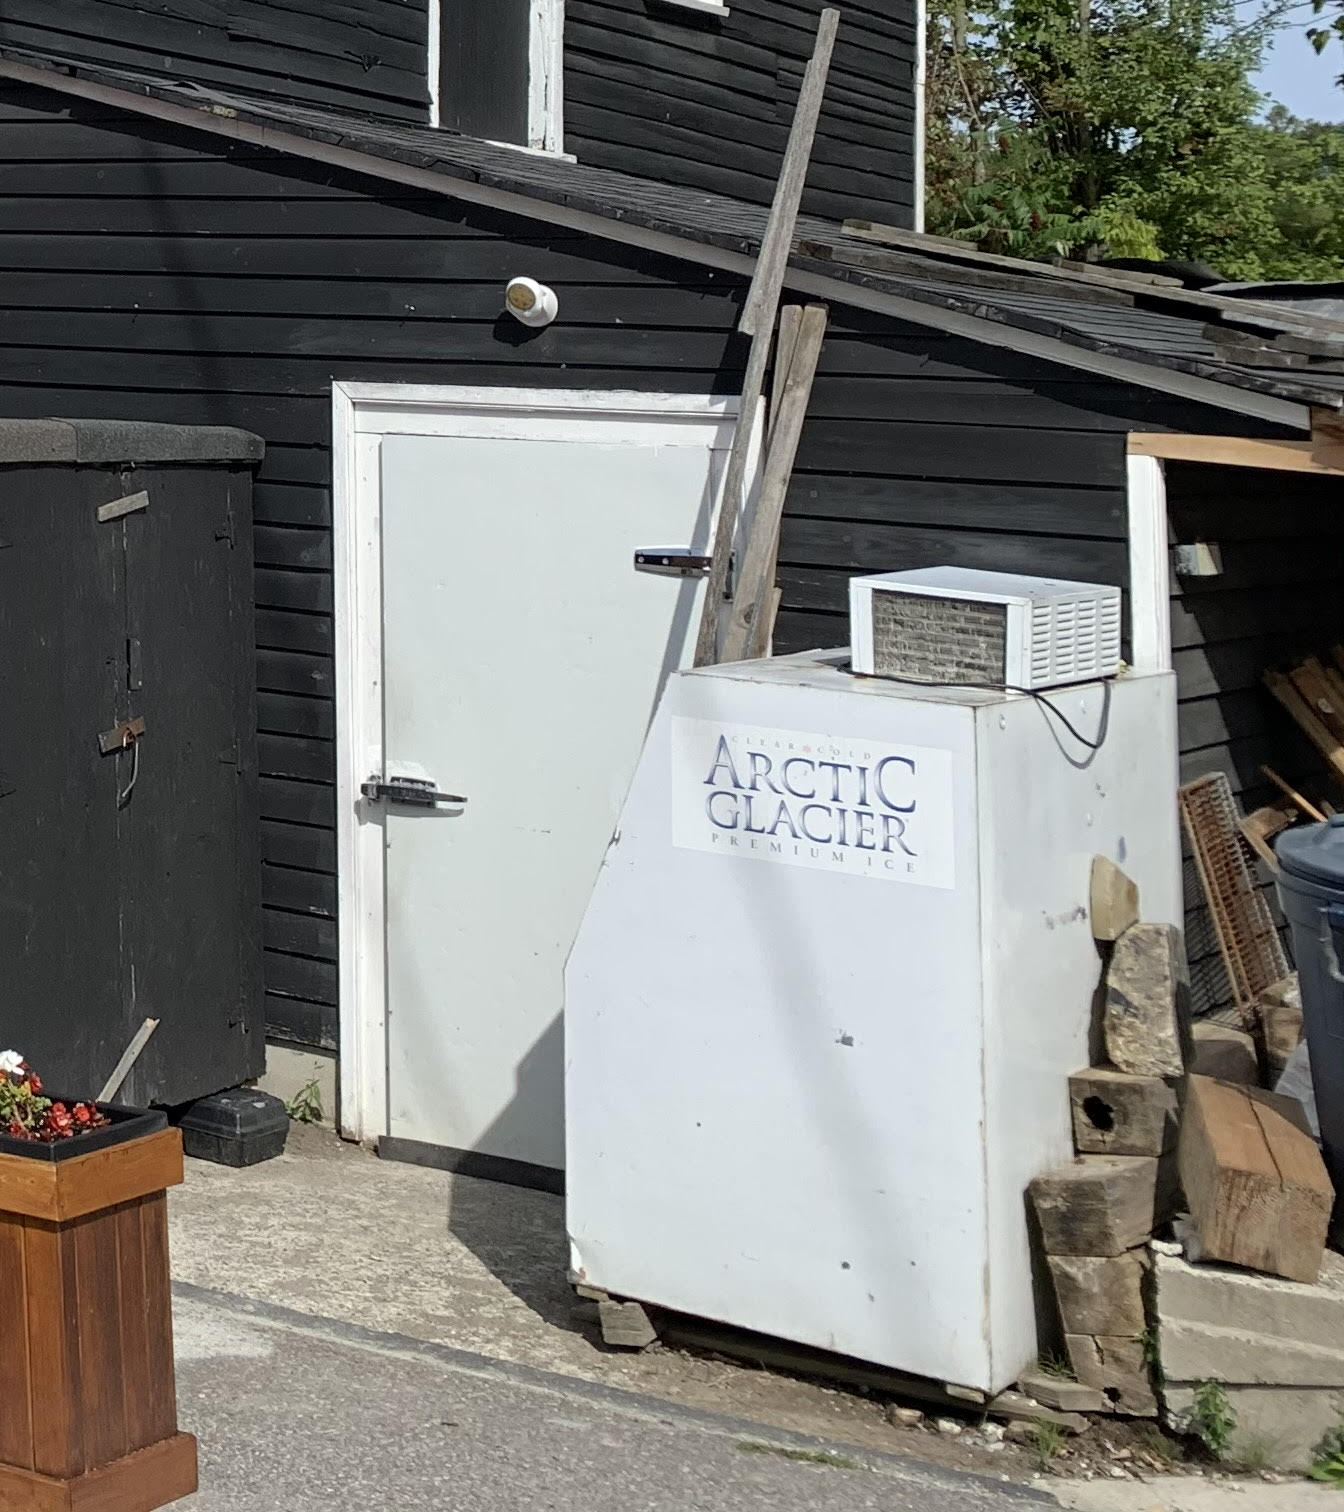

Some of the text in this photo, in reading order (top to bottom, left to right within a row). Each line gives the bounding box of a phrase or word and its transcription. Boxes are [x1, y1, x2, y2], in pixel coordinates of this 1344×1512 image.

[703, 734, 916, 813] ARCTIC
[731, 735, 871, 760] CLEAR COLD
[705, 790, 919, 857] GLACIER
[711, 832, 915, 873] PREMIUM ICE
